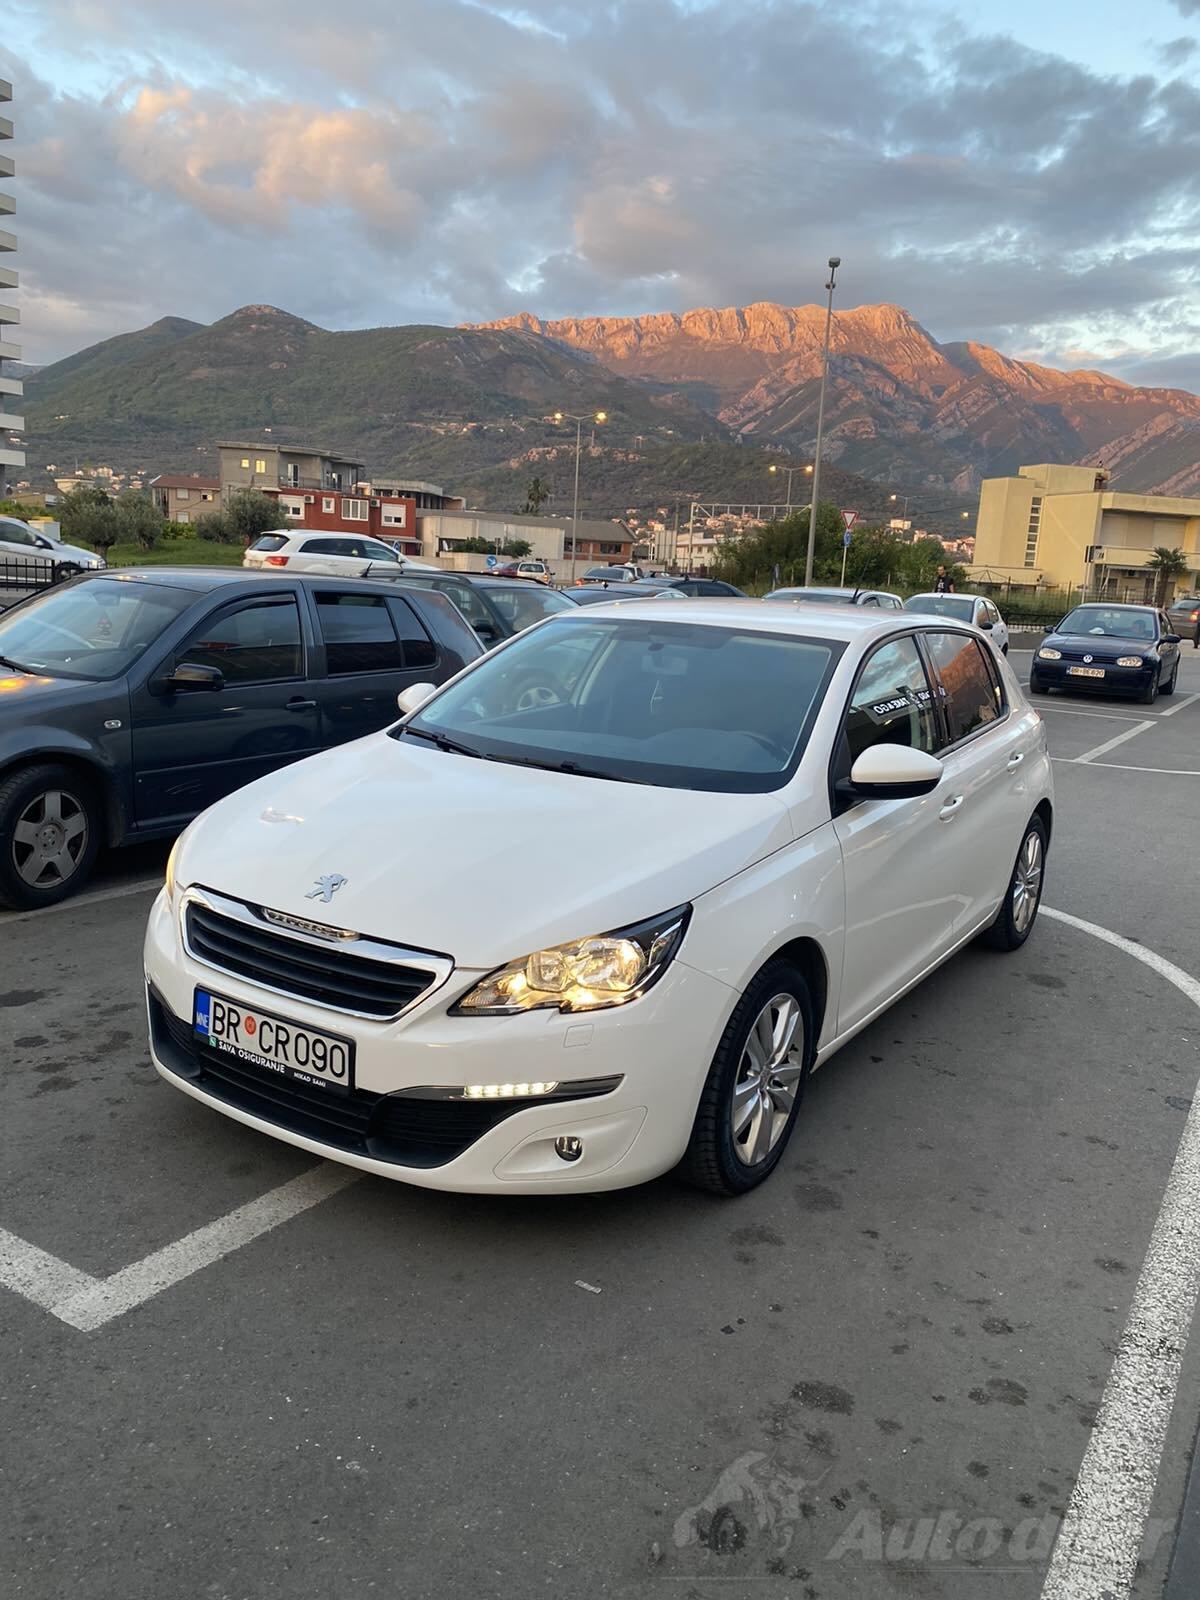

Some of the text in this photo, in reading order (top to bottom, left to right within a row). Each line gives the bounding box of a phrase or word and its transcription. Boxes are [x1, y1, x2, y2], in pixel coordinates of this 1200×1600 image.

[212, 1001, 346, 1078] BR CR090
[218, 1040, 286, 1074] SAVA OSIGURANJE
